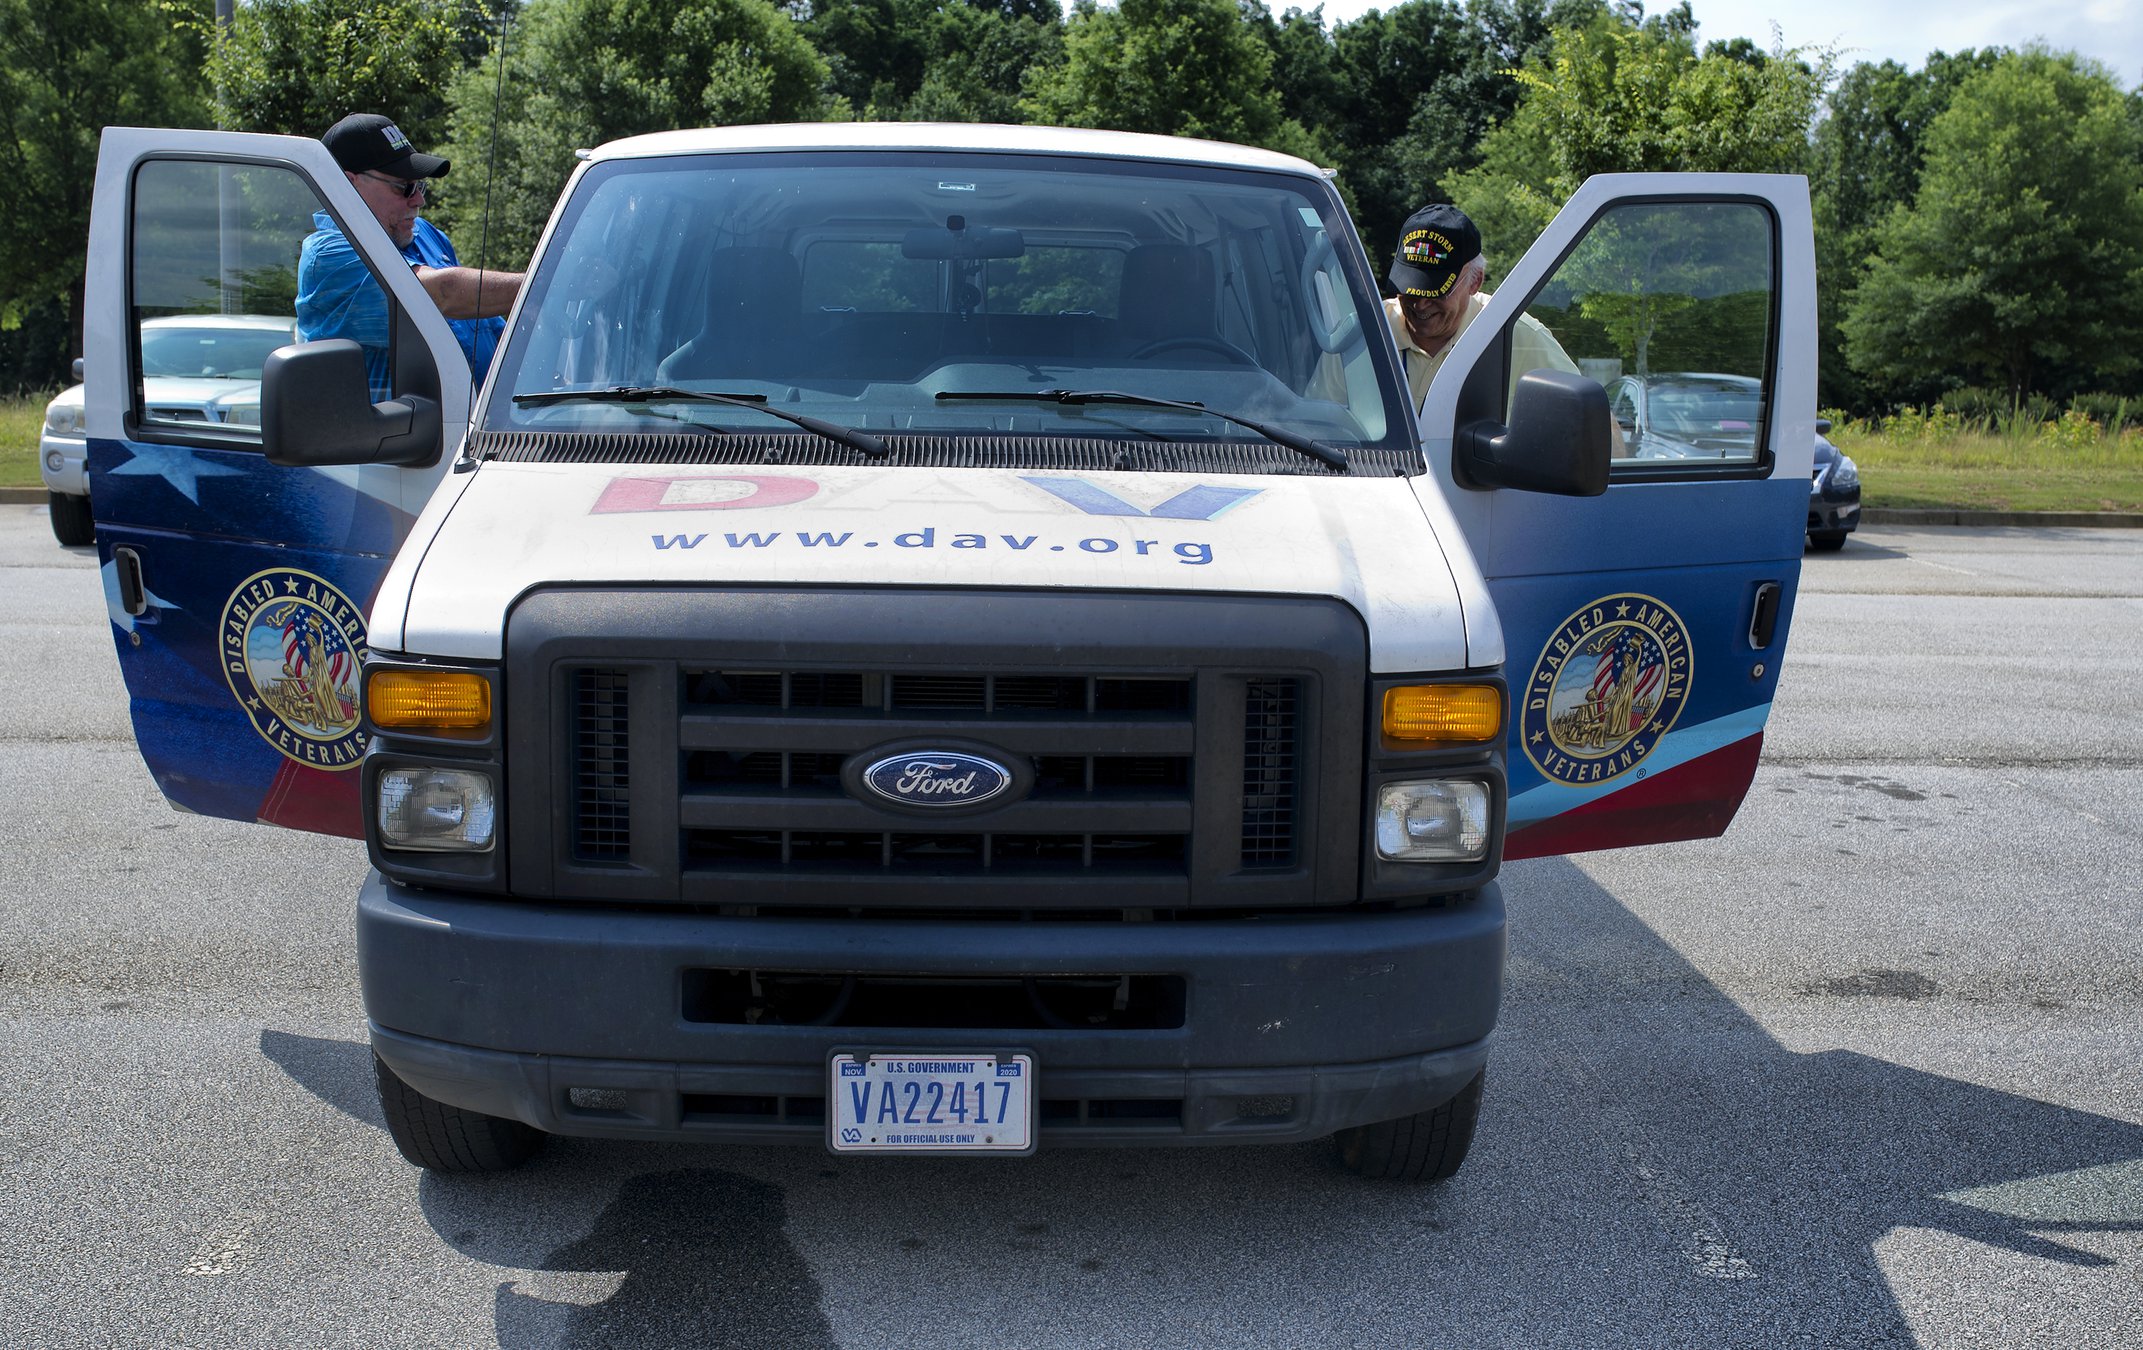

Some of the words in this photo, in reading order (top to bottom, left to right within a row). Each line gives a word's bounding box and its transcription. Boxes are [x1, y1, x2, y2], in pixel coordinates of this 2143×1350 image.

[1403, 229, 1428, 247] DESERT
[1428, 231, 1454, 253] STORM
[1406, 253, 1439, 265] VETERAN
[1406, 287, 1439, 297] PROUDLY
[1440, 273, 1457, 294] SERVED
[651, 527, 1214, 565] www.dav.org
[227, 579, 275, 673] DISABLED
[306, 583, 369, 661] AMERIC
[1530, 607, 1604, 710] DISABLED
[1635, 604, 1686, 699] AMERICAN
[266, 717, 366, 764] VETERANS
[896, 761, 977, 794] Ford
[1543, 739, 1646, 781] VETERANS
[887, 1062, 906, 1073] U.S.
[907, 1062, 975, 1073] GOVERNMENT
[851, 1081, 1011, 1124] VA22417
[886, 1134, 902, 1144] FOR
[903, 1134, 938, 1144] OFFICIAL
[939, 1134, 955, 1144] USE
[956, 1134, 975, 1144] ONLY
